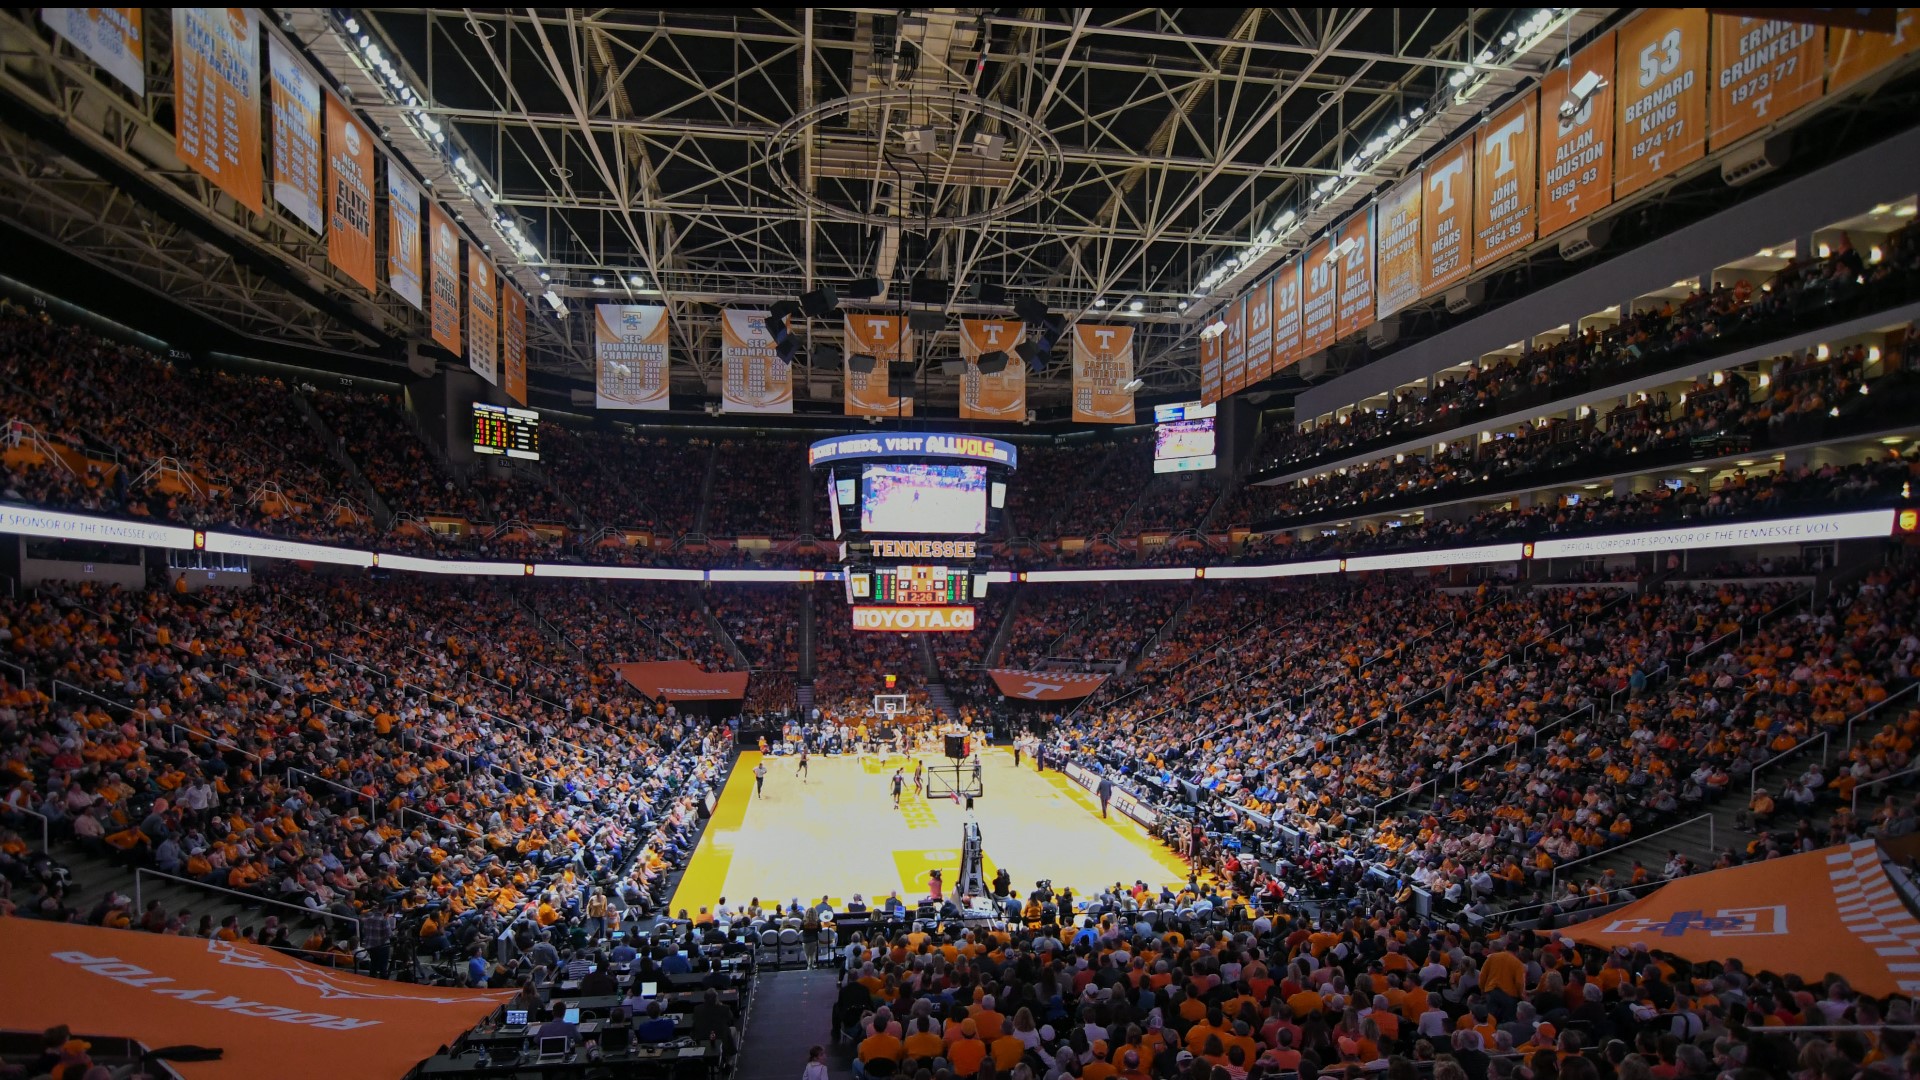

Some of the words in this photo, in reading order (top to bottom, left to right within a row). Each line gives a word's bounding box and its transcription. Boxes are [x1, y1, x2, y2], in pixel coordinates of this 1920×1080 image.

[1639, 28, 1681, 88] 53
[1720, 23, 1815, 89] GRUNFELD
[1625, 70, 1694, 124] BERNARD
[1752, 93, 1772, 118] T
[1640, 101, 1677, 135] KING
[1486, 113, 1525, 180] T
[1556, 128, 1593, 163] ALLAN
[1632, 120, 1684, 160] 1974-77
[342, 152, 362, 178] MEN'S
[1546, 141, 1604, 186] HOUSTON
[1649, 151, 1665, 172] T
[332, 155, 371, 200] BASKETBALL
[1430, 156, 1463, 215] T
[338, 179, 368, 219] ELITE
[1490, 178, 1517, 205] JOHN
[336, 196, 369, 238] EIGHT
[1489, 195, 1518, 222] WARD
[1566, 195, 1580, 214] T
[1391, 210, 1406, 232] PAT
[1438, 216, 1455, 237] RAY
[1503, 216, 1514, 227] THE
[1380, 219, 1418, 254] SUMMITT
[1431, 229, 1461, 255] MEARS
[1485, 221, 1522, 250] 1964-99
[1311, 262, 1328, 294] 30
[1346, 269, 1364, 290] HOLLY
[1431, 255, 1459, 279] 1962-77
[437, 271, 455, 295] SWEET
[1341, 280, 1370, 305] WARLICK
[434, 282, 457, 310] SIXTEEN
[1280, 282, 1295, 312] 32
[1304, 288, 1334, 314] BRIDGETTE
[1253, 302, 1266, 331] 23
[1308, 304, 1331, 325] GORDON
[623, 335, 641, 344] SEC
[868, 320, 890, 339] T
[983, 325, 1004, 344] T
[1095, 330, 1115, 349] T
[1229, 318, 1240, 345] 24
[602, 343, 663, 353] TOURNAMENT
[602, 351, 662, 361] CHAMPIONS
[728, 347, 777, 357] CHAMPIO
[748, 339, 766, 348] SEC
[1083, 369, 1127, 378] DIVISION
[1084, 360, 1126, 370] EASTERN
[339, 377, 353, 386] 325
[1092, 378, 1117, 386] TITLE
[885, 438, 923, 451] VISIT
[9, 513, 61, 529] SPONSOR
[63, 521, 76, 531] OF
[80, 522, 96, 533] THE
[100, 525, 145, 539] TENNESSEE
[148, 531, 168, 542] VOLS
[1561, 543, 1594, 553] OFFICIAL
[1596, 538, 1646, 550] CORPORATE
[1649, 533, 1693, 545] SPONSOR
[1696, 532, 1710, 542] OF
[1714, 531, 1733, 540] THE
[1737, 525, 1801, 539] TENNESSEE
[1806, 522, 1839, 534] VOLS
[870, 540, 976, 558] TENNESSEE
[816, 571, 825, 580] 27
[852, 577, 867, 594] T
[911, 592, 933, 602] 2:26
[1017, 681, 1064, 700] T
[51, 951, 176, 989] TOP
[151, 988, 384, 1030] ROCKY
